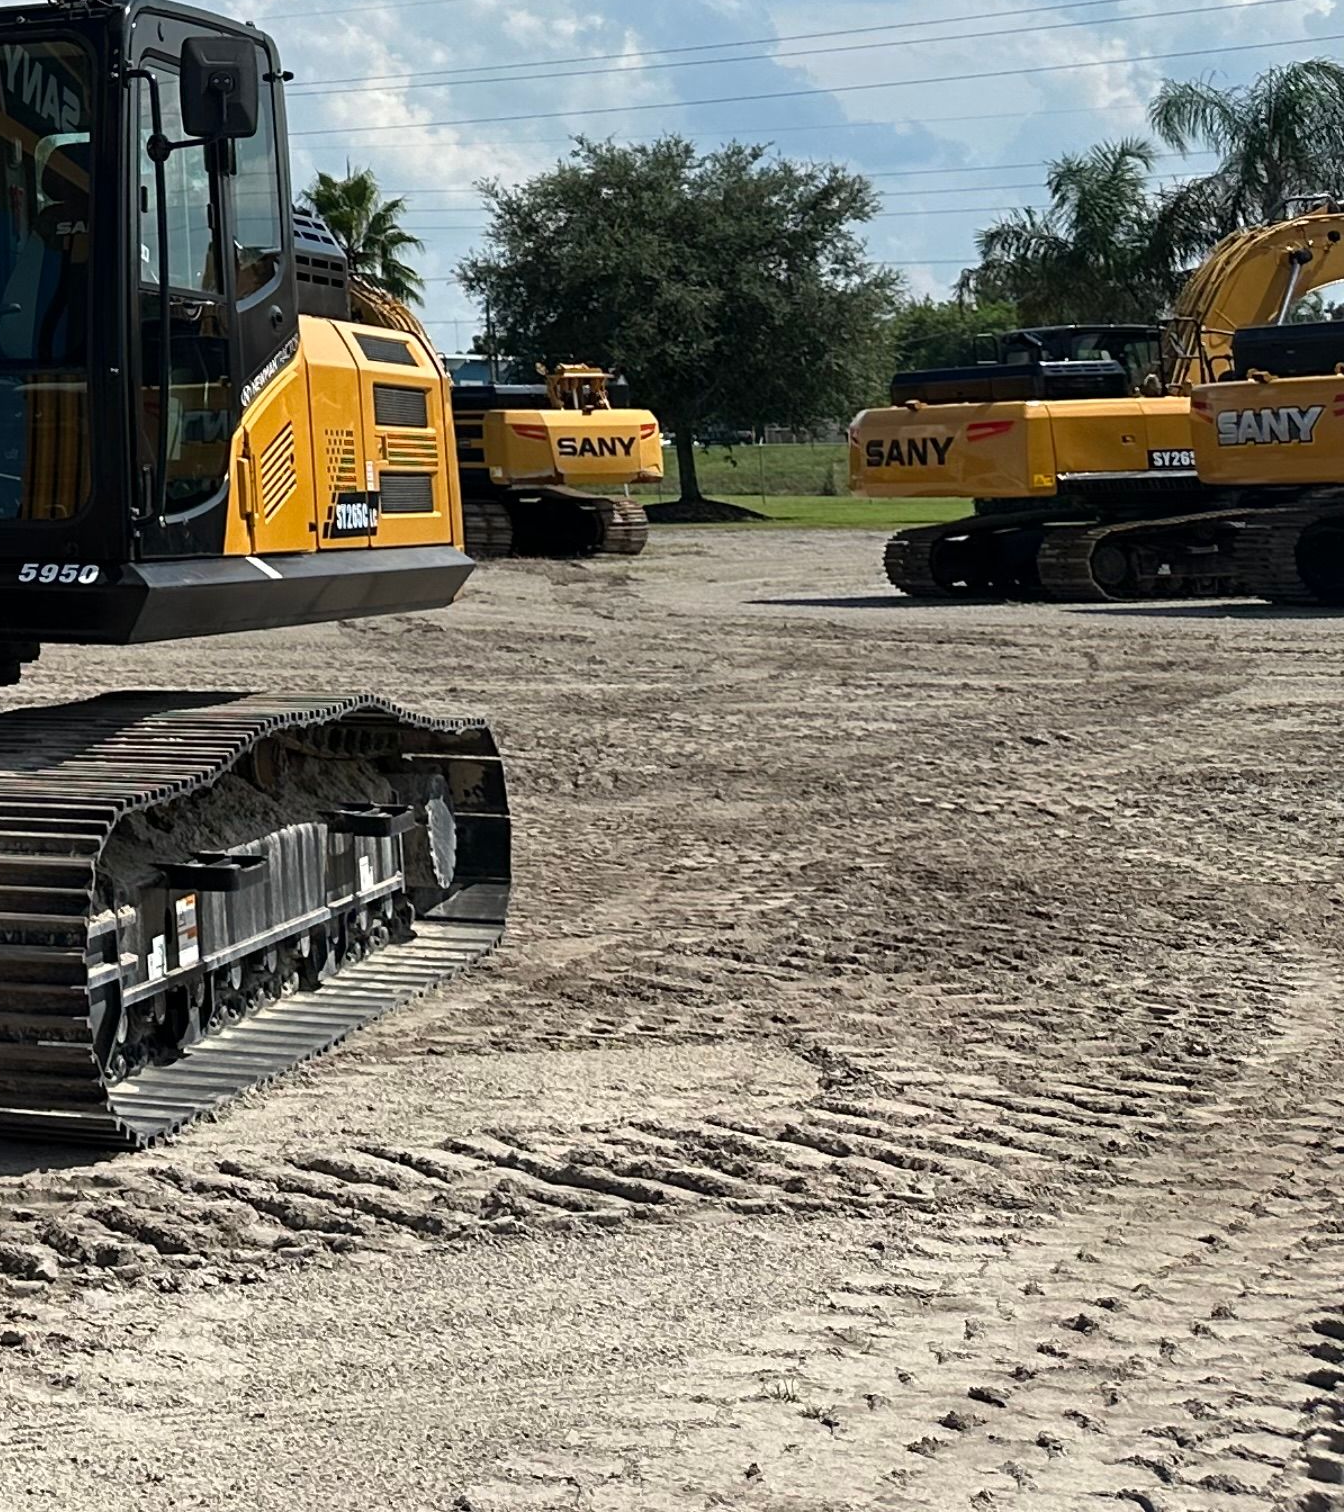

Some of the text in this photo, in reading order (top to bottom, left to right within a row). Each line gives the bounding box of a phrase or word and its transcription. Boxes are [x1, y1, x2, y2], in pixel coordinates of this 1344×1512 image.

[1217, 404, 1325, 447] SANY
[557, 436, 637, 457] SANY
[866, 436, 955, 467] SANY
[18, 563, 100, 585] 5950
